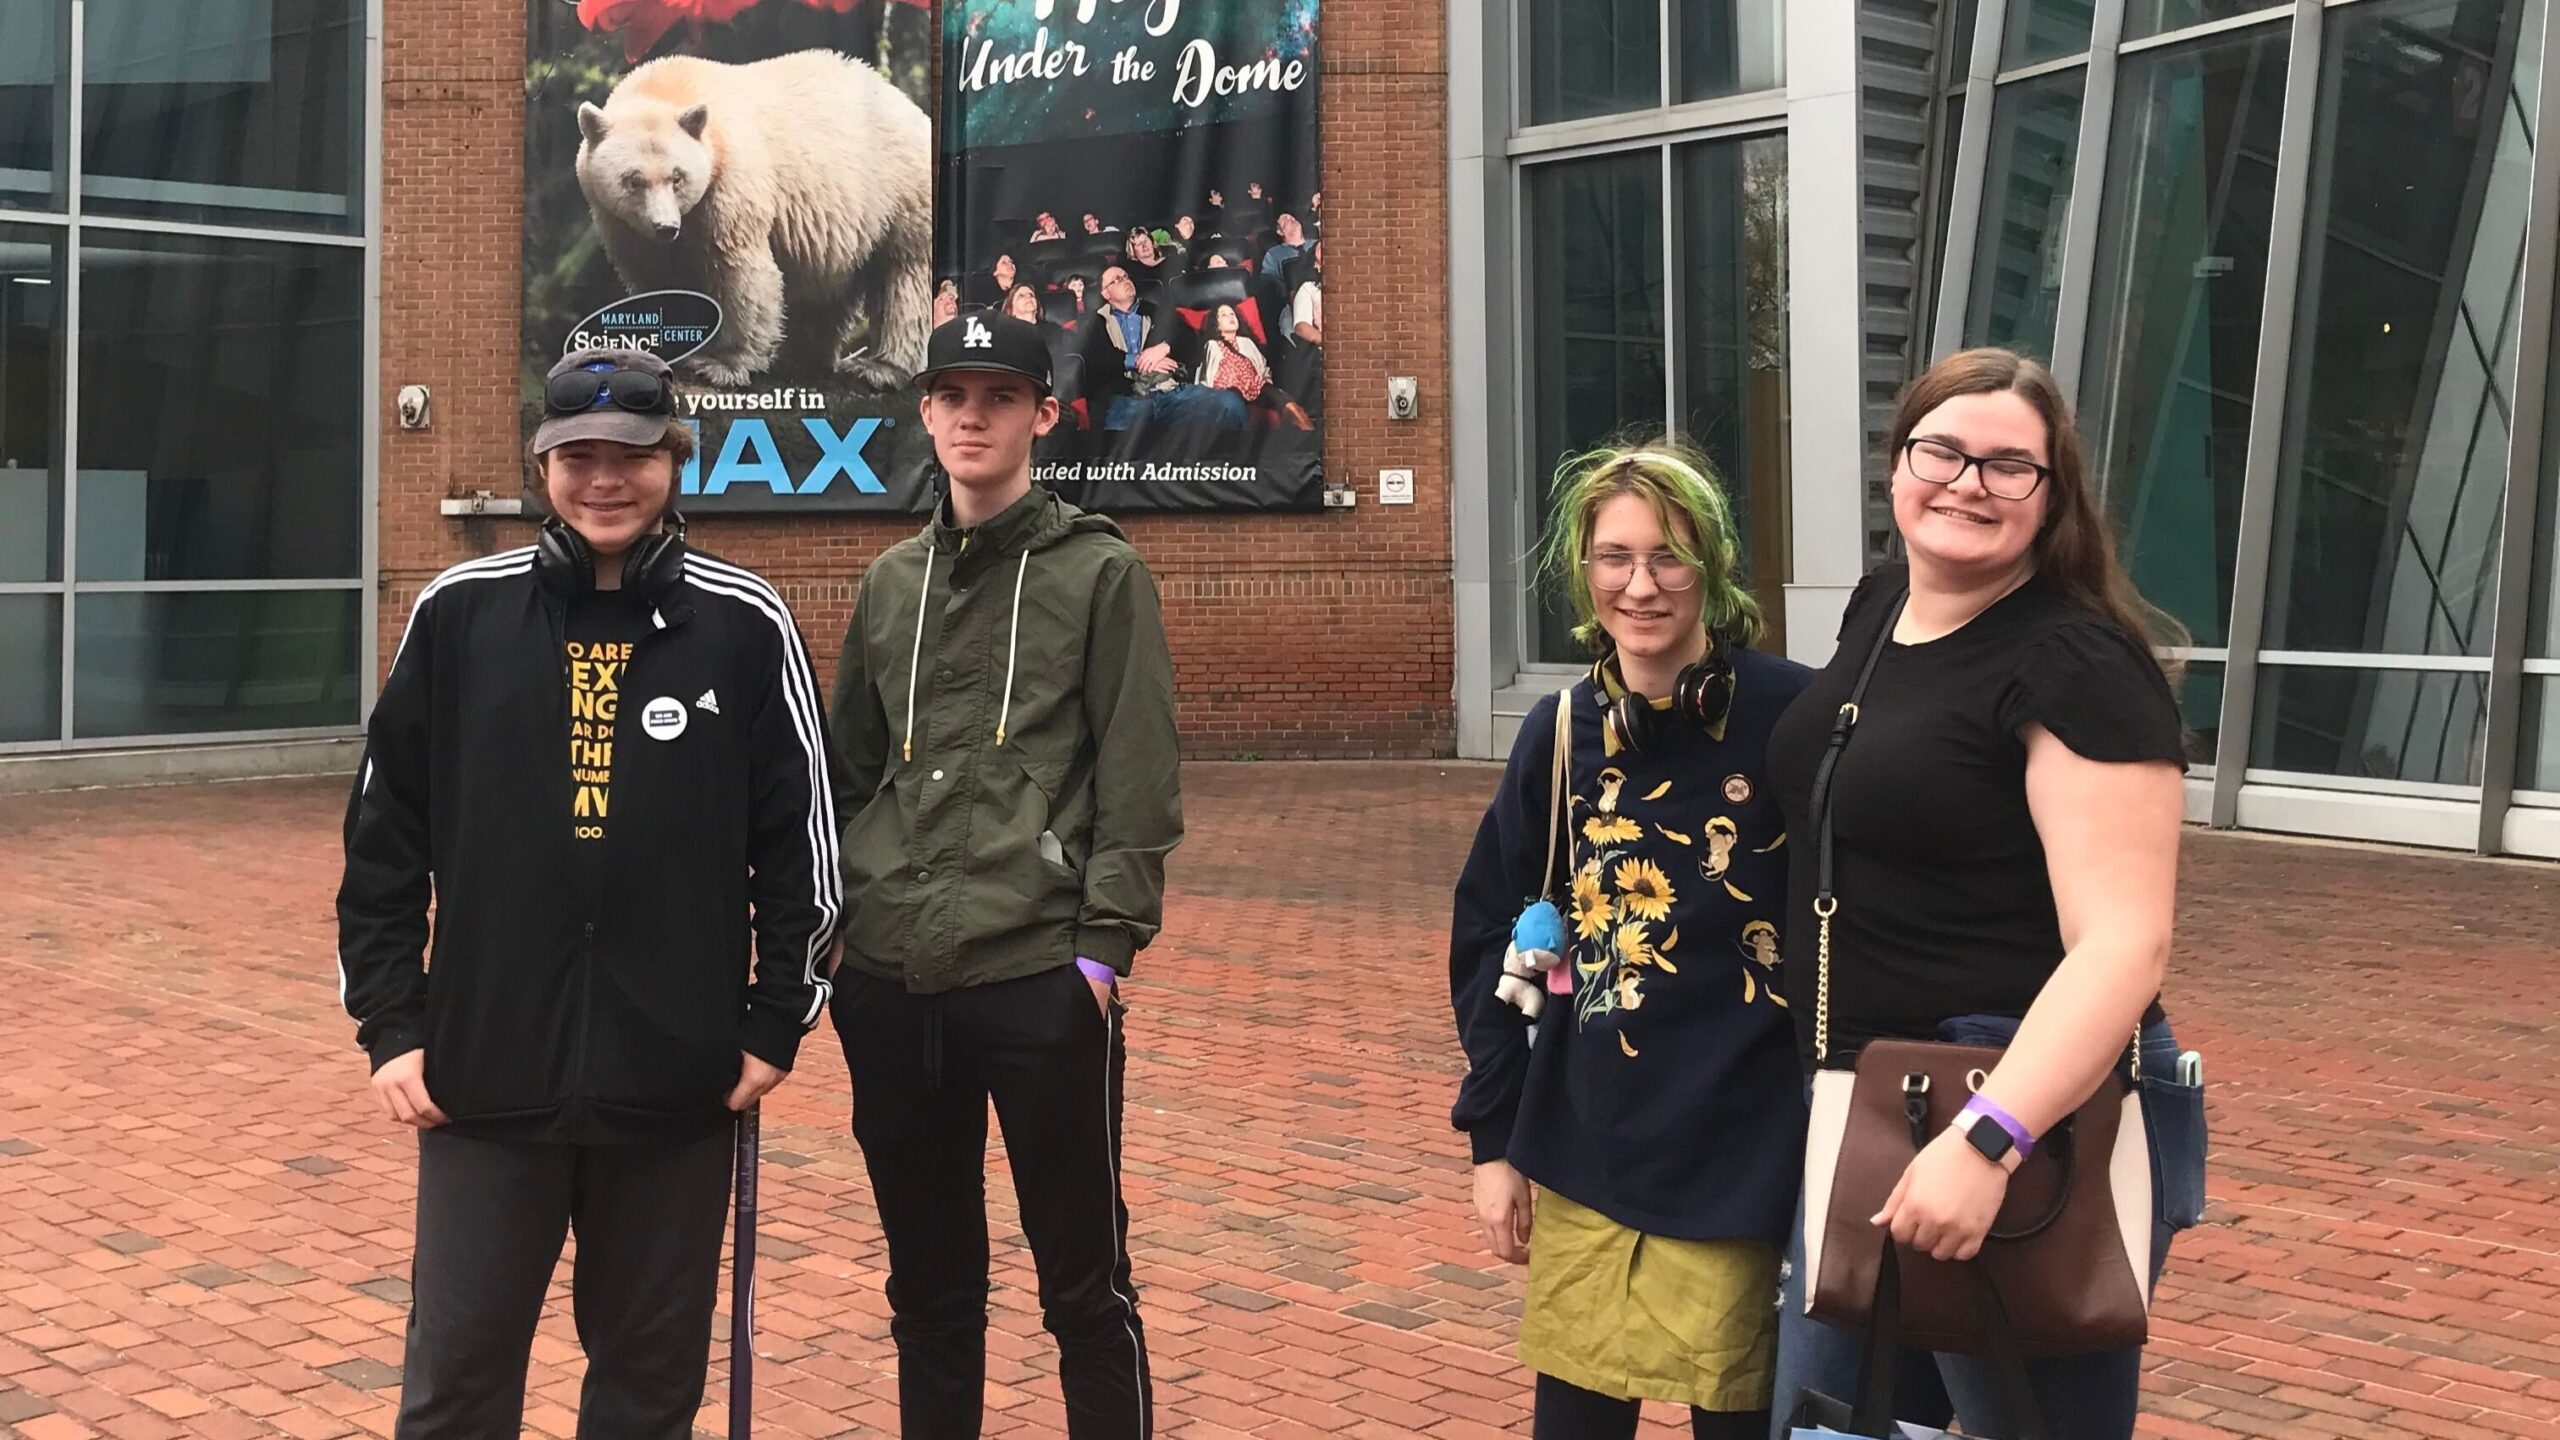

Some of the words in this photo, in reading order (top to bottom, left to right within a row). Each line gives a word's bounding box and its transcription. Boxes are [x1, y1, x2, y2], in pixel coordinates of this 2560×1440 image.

[958, 26, 1091, 92] Under
[1111, 46, 1156, 85] the
[1172, 38, 1307, 108] Dome
[601, 313, 659, 325] MARYLAND
[664, 330, 703, 342] CENTER
[963, 316, 992, 348] LA
[685, 388, 796, 415] yourself
[799, 388, 826, 410] in
[1086, 462, 1135, 481] with
[1140, 462, 1257, 481] Admission
[589, 642, 634, 660] ARE
